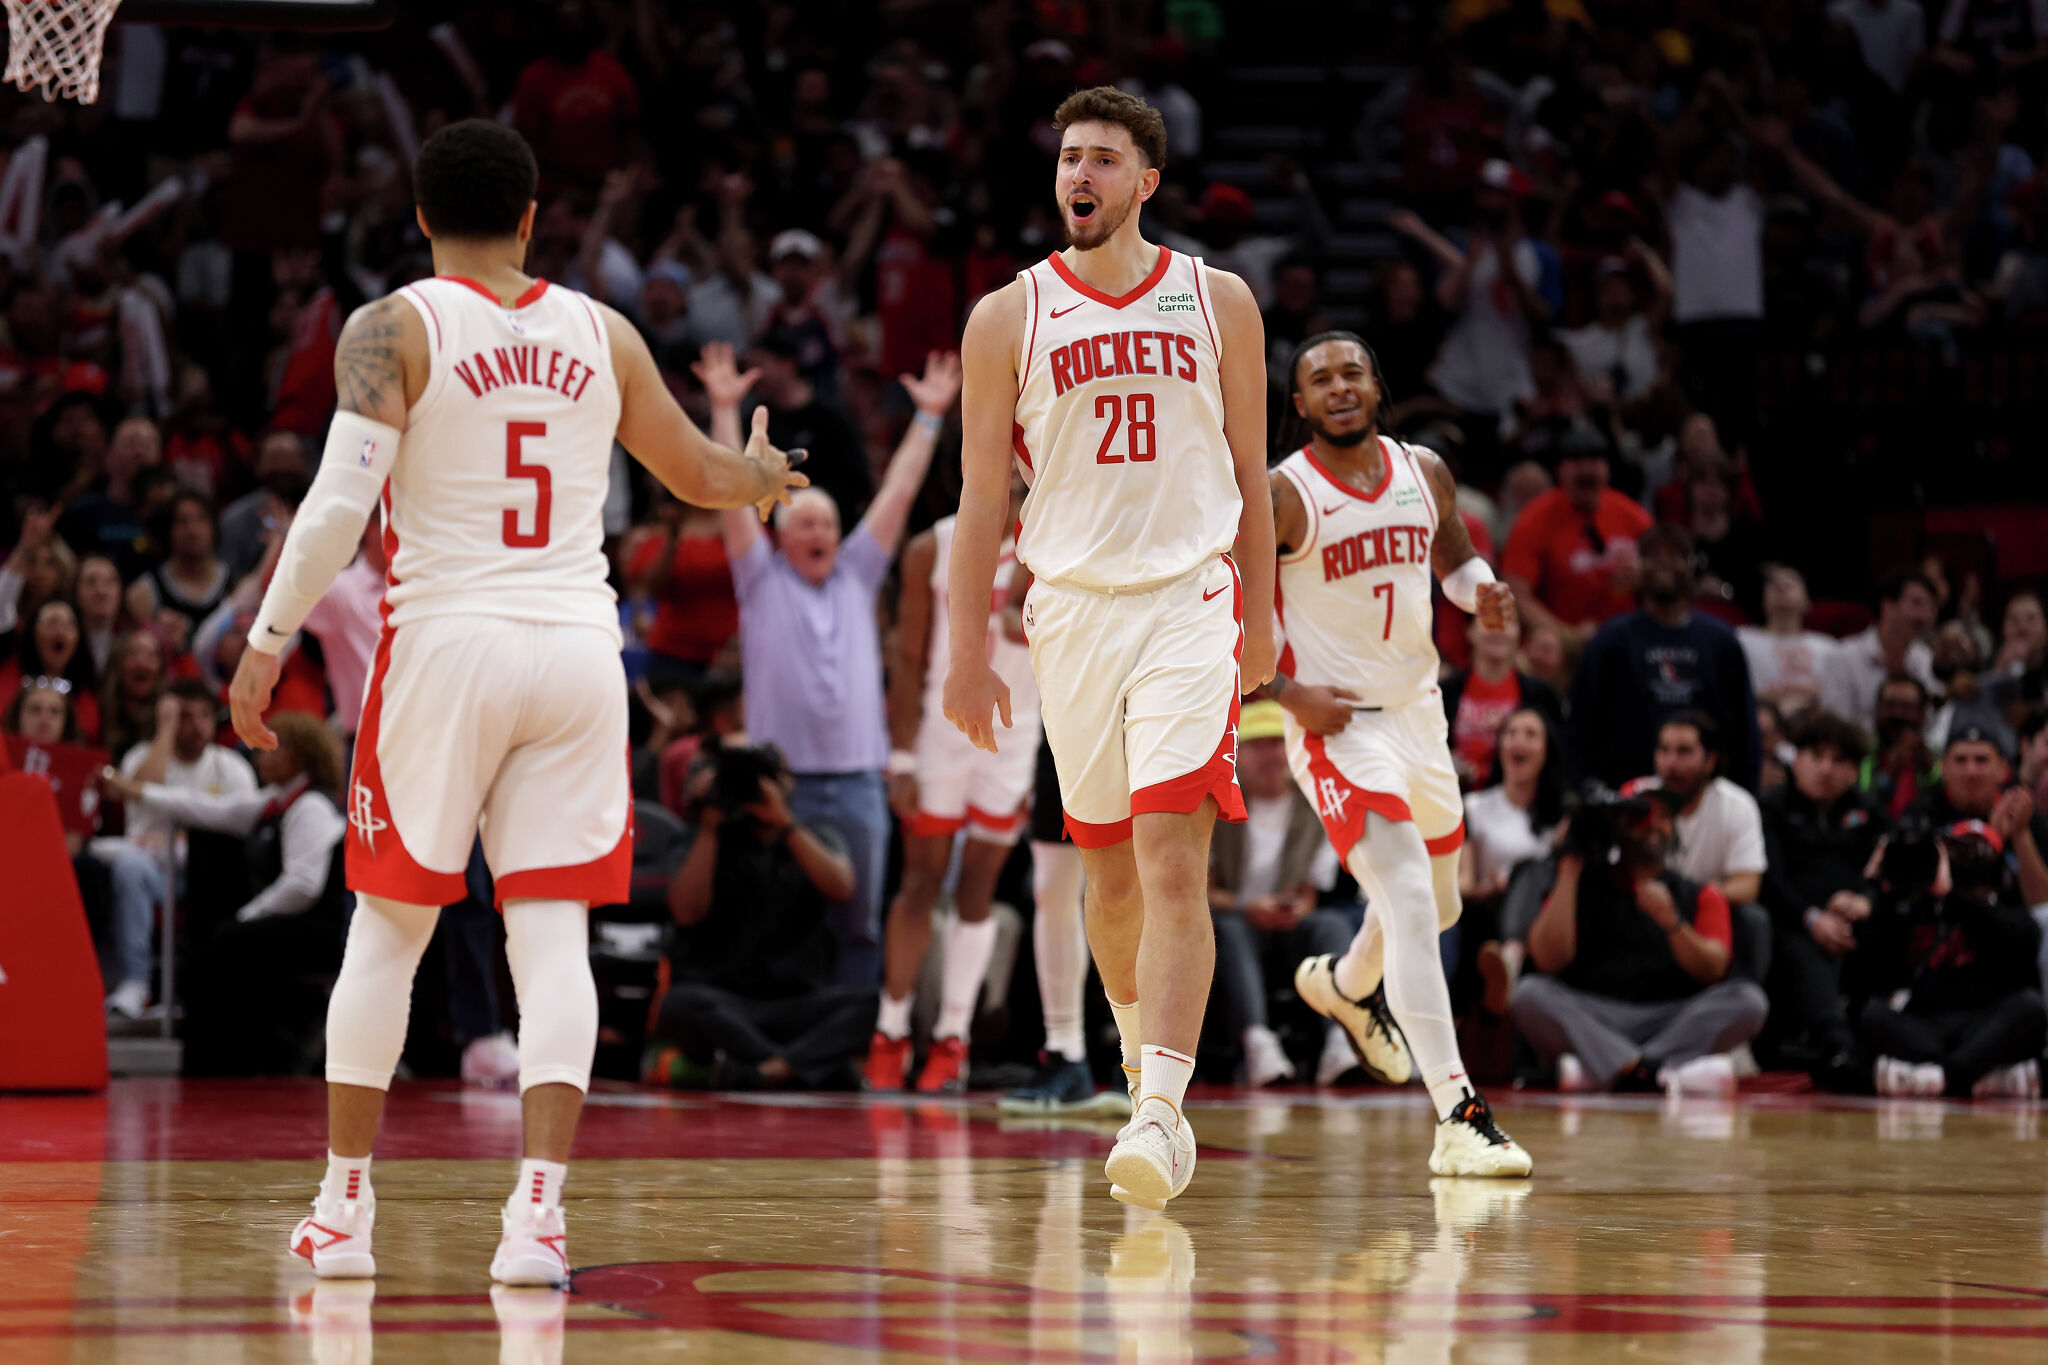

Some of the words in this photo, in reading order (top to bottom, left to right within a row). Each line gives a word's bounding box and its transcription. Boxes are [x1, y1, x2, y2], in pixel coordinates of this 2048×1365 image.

[1157, 303, 1196, 312] karma
[1158, 293, 1195, 303] credit
[454, 346, 595, 402] VANVLEET
[1050, 331, 1197, 398] ROCKETS
[1095, 393, 1156, 464] 28
[502, 421, 552, 548] 5
[1322, 525, 1429, 582] ROCKETS
[1373, 581, 1394, 641] 7
